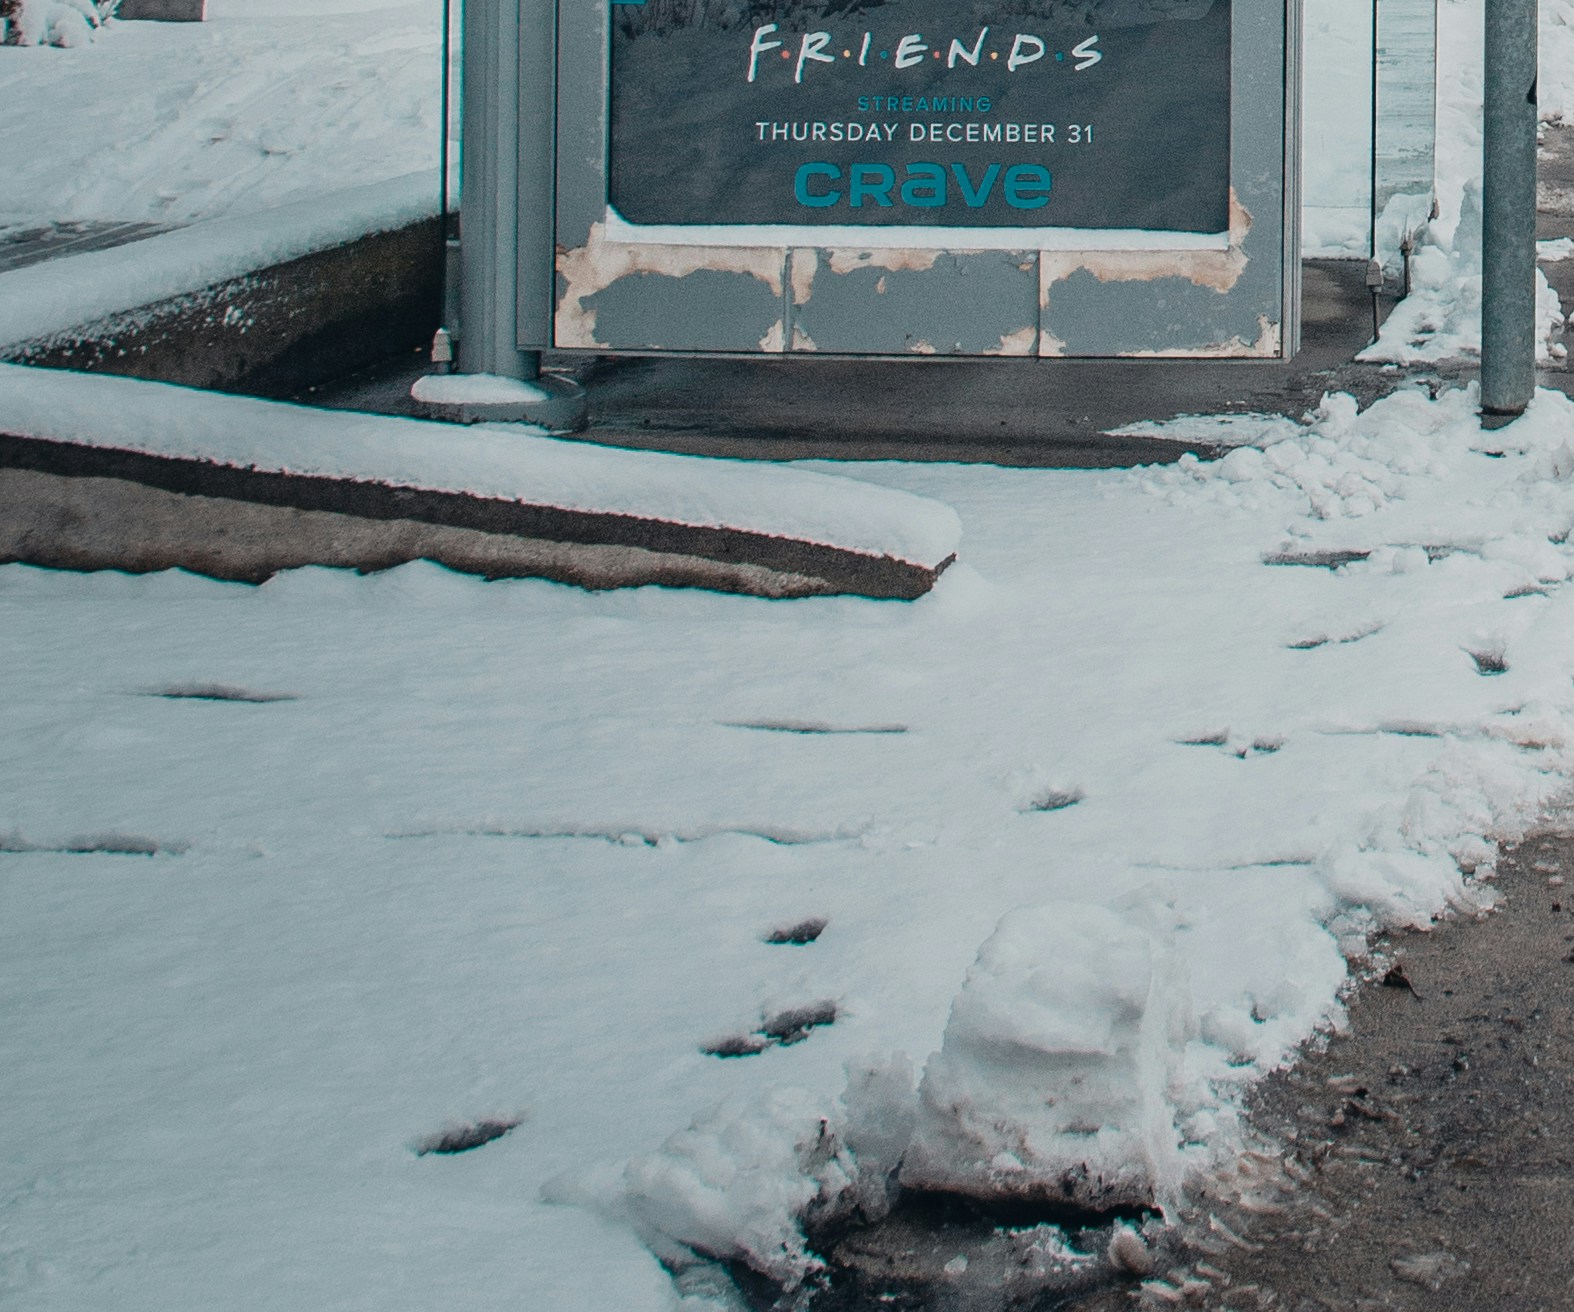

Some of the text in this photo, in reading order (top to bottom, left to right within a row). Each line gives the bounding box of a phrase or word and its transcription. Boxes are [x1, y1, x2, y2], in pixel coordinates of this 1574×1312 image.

[857, 95, 992, 113] STREAMING
[755, 121, 1093, 144] THURSDAY DECEMBER 31
